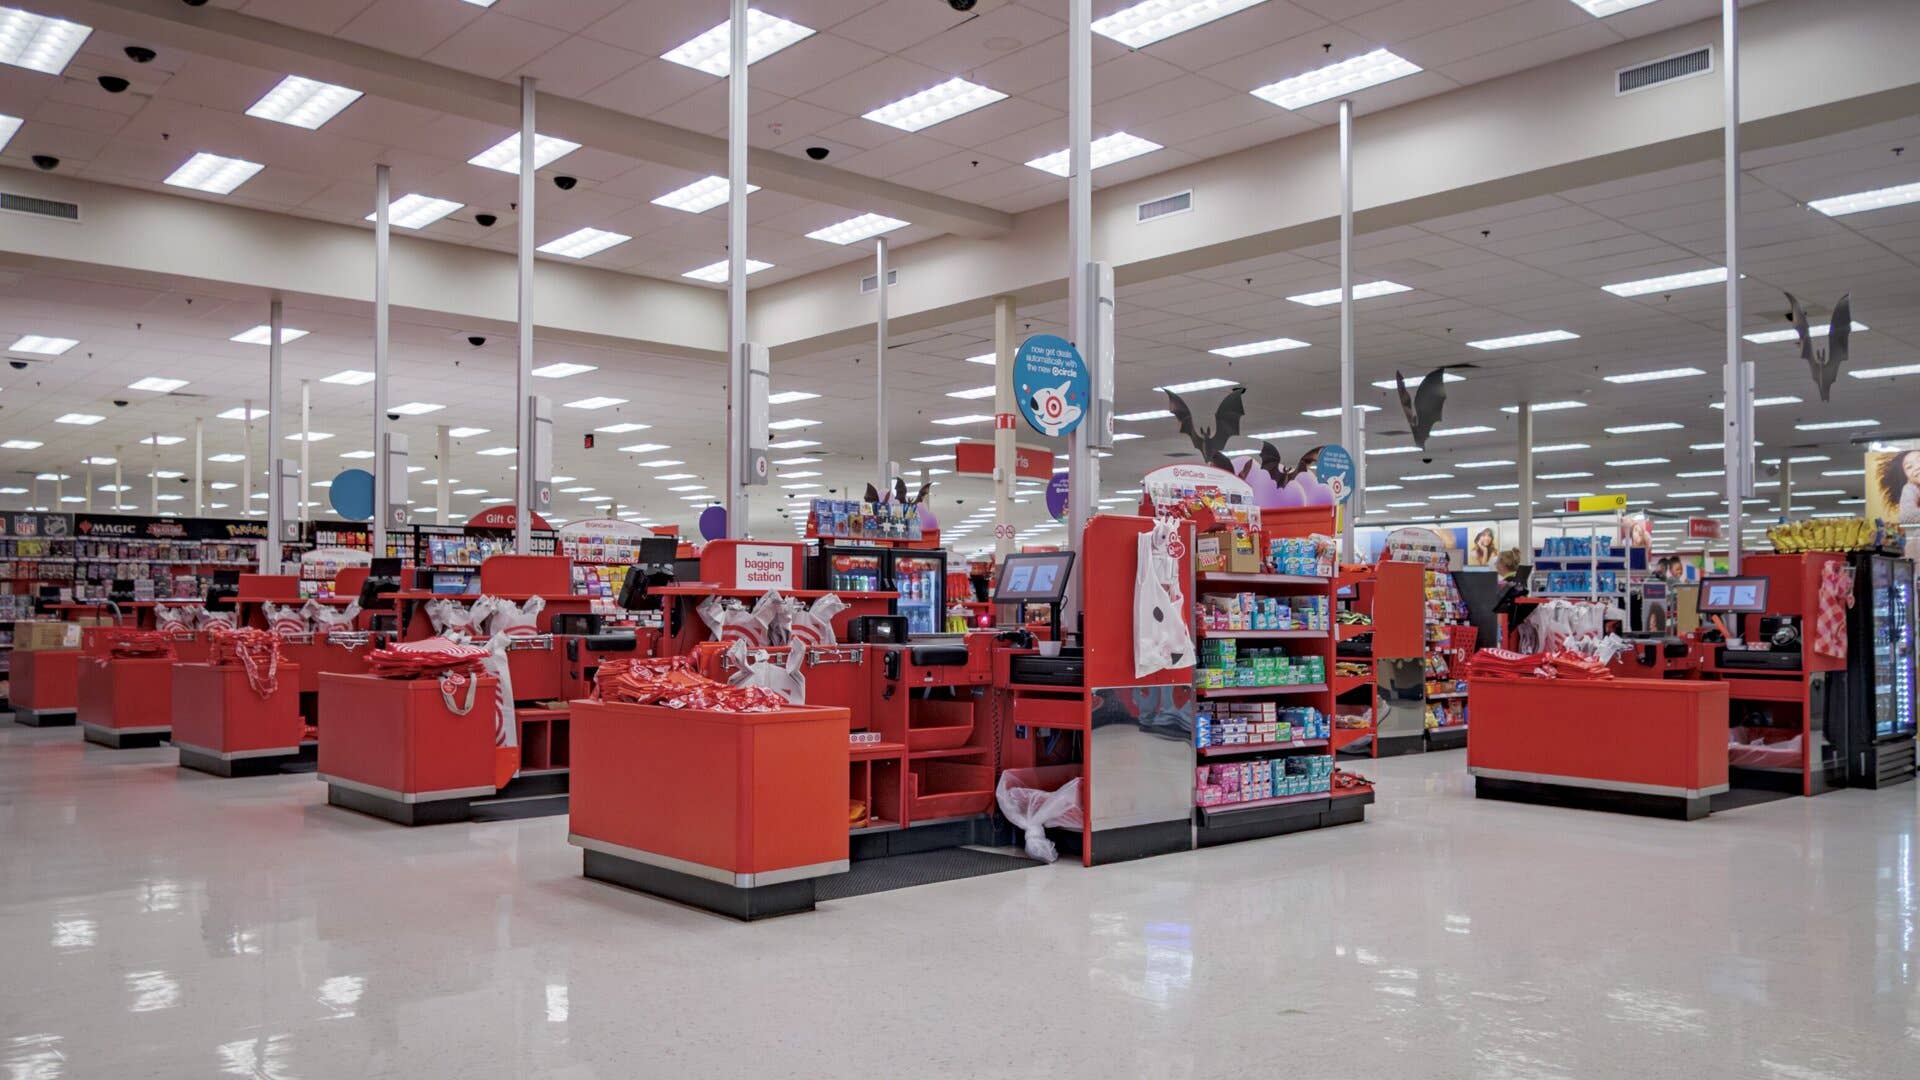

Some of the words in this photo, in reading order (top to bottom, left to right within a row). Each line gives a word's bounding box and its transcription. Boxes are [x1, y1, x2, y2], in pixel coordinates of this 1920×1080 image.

[1031, 346, 1044, 354] now
[1045, 348, 1056, 356] get
[1056, 350, 1072, 358] deals
[1026, 354, 1064, 367] automatically
[1064, 359, 1078, 369] with
[1026, 363, 1037, 371] the
[1037, 365, 1051, 374] new
[486, 514, 504, 524] Gift
[91, 524, 136, 534] MAGIC
[744, 557, 785, 572] bagging
[747, 571, 782, 582] station
